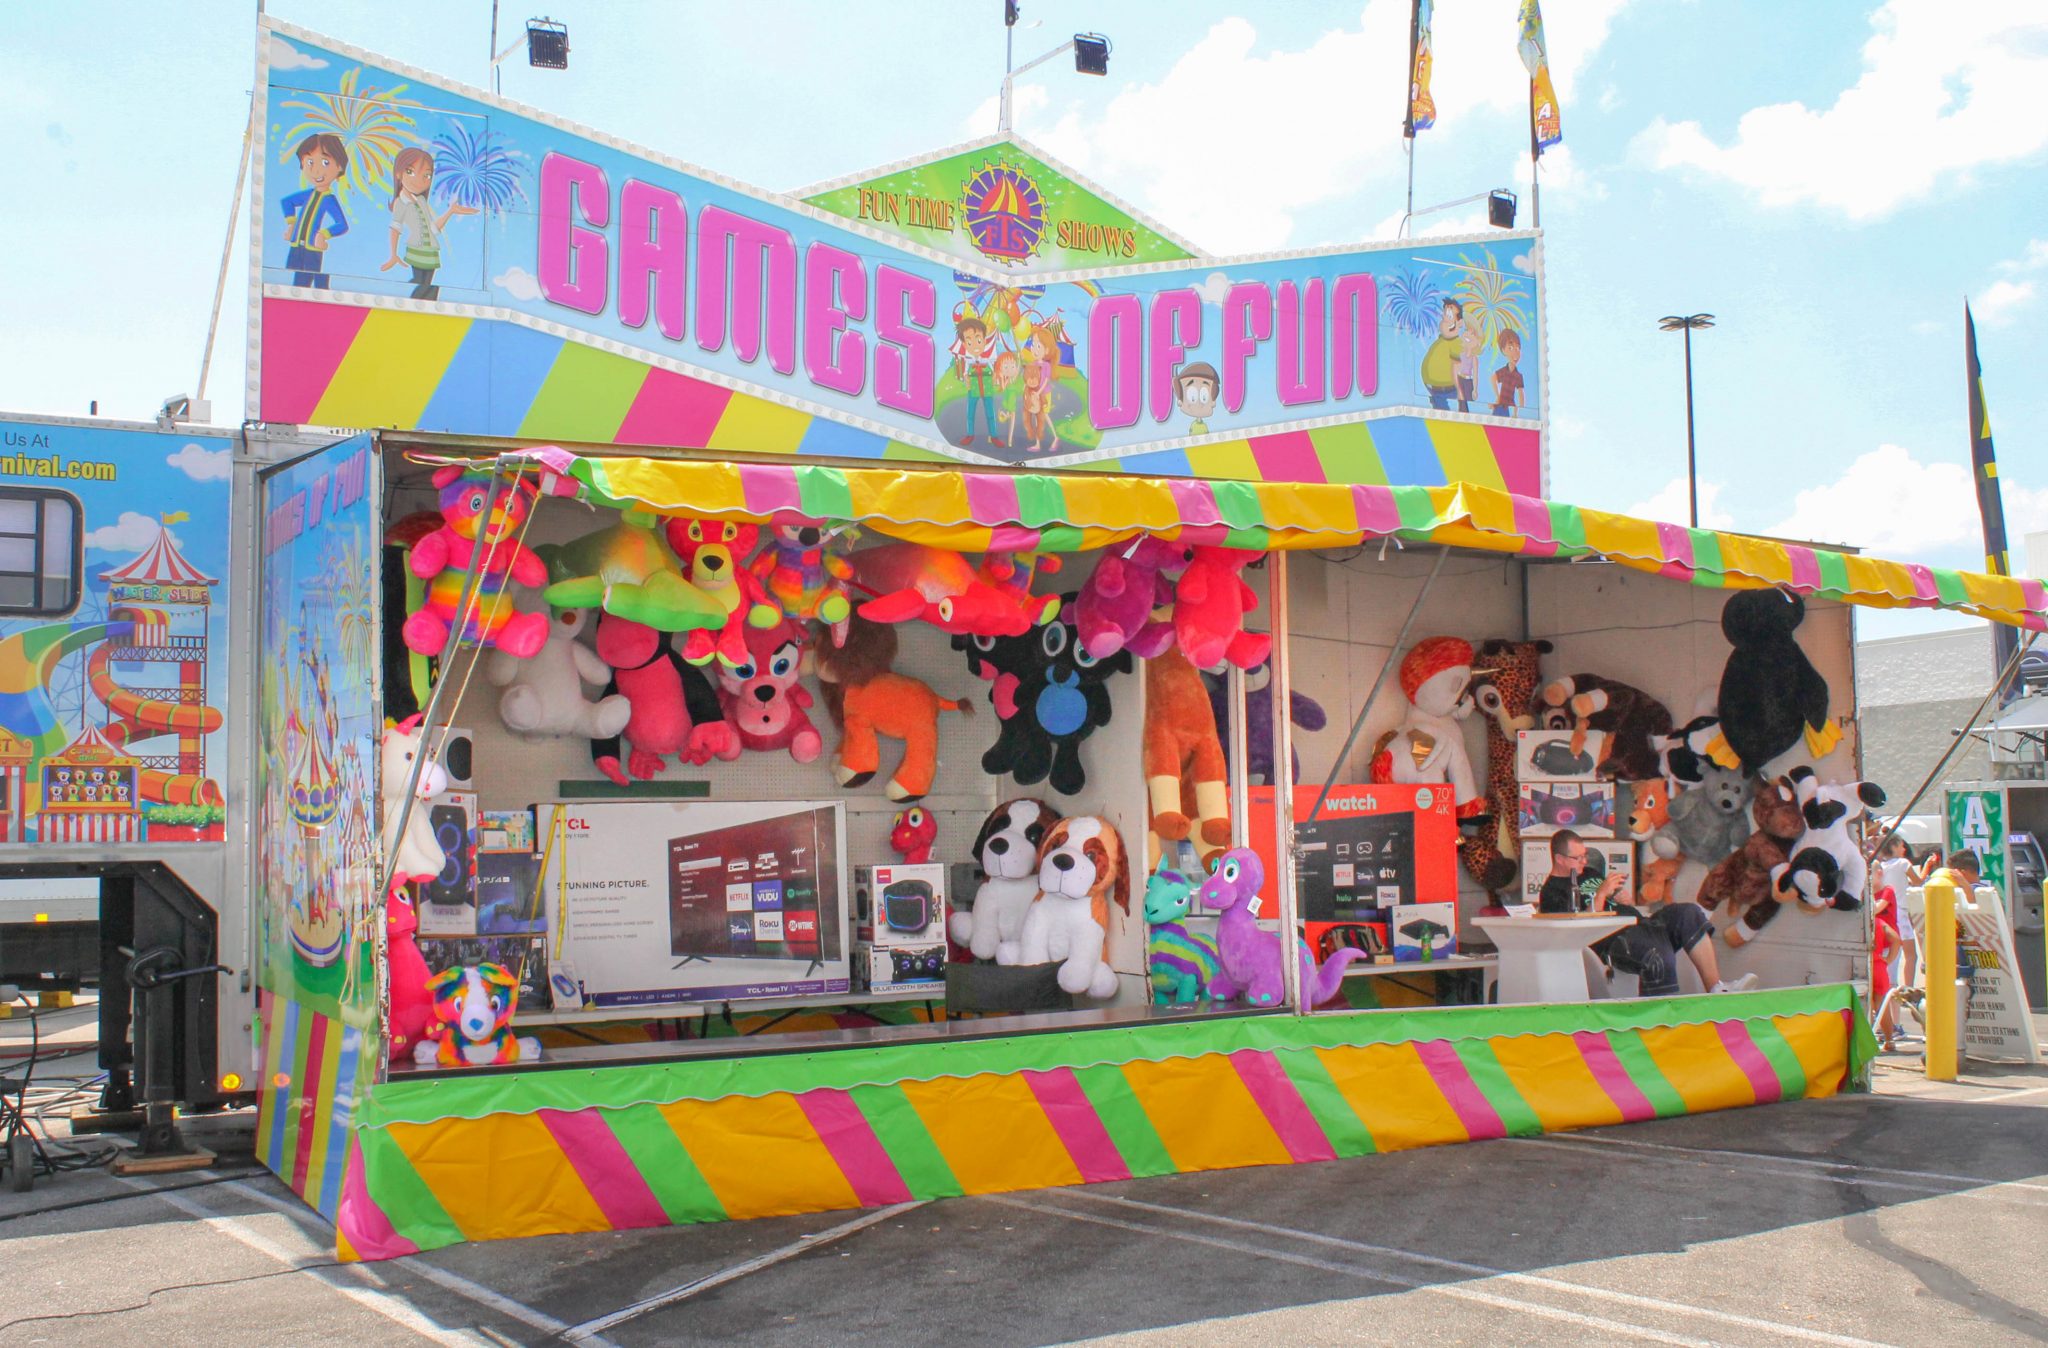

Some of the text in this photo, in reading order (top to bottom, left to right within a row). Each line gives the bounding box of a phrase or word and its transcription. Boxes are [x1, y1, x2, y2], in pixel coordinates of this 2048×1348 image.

[857, 186, 955, 234] FUN TIME
[985, 214, 1025, 251] FTS
[1056, 219, 1138, 258] SHOWS
[537, 149, 936, 421] GAMES
[1087, 272, 1379, 430] OF FUN
[5, 432, 49, 448] Us At
[0, 452, 116, 481] nival.com
[112, 585, 210, 603] WATER SLIDE
[1325, 794, 1377, 812] watch
[1435, 804, 1450, 816] 4K
[1962, 796, 1992, 888] AT
[729, 893, 749, 901] NETFLIX
[757, 891, 779, 902] VUDU
[1336, 894, 1352, 902] hulu
[873, 984, 916, 992] BLUETOOTH
